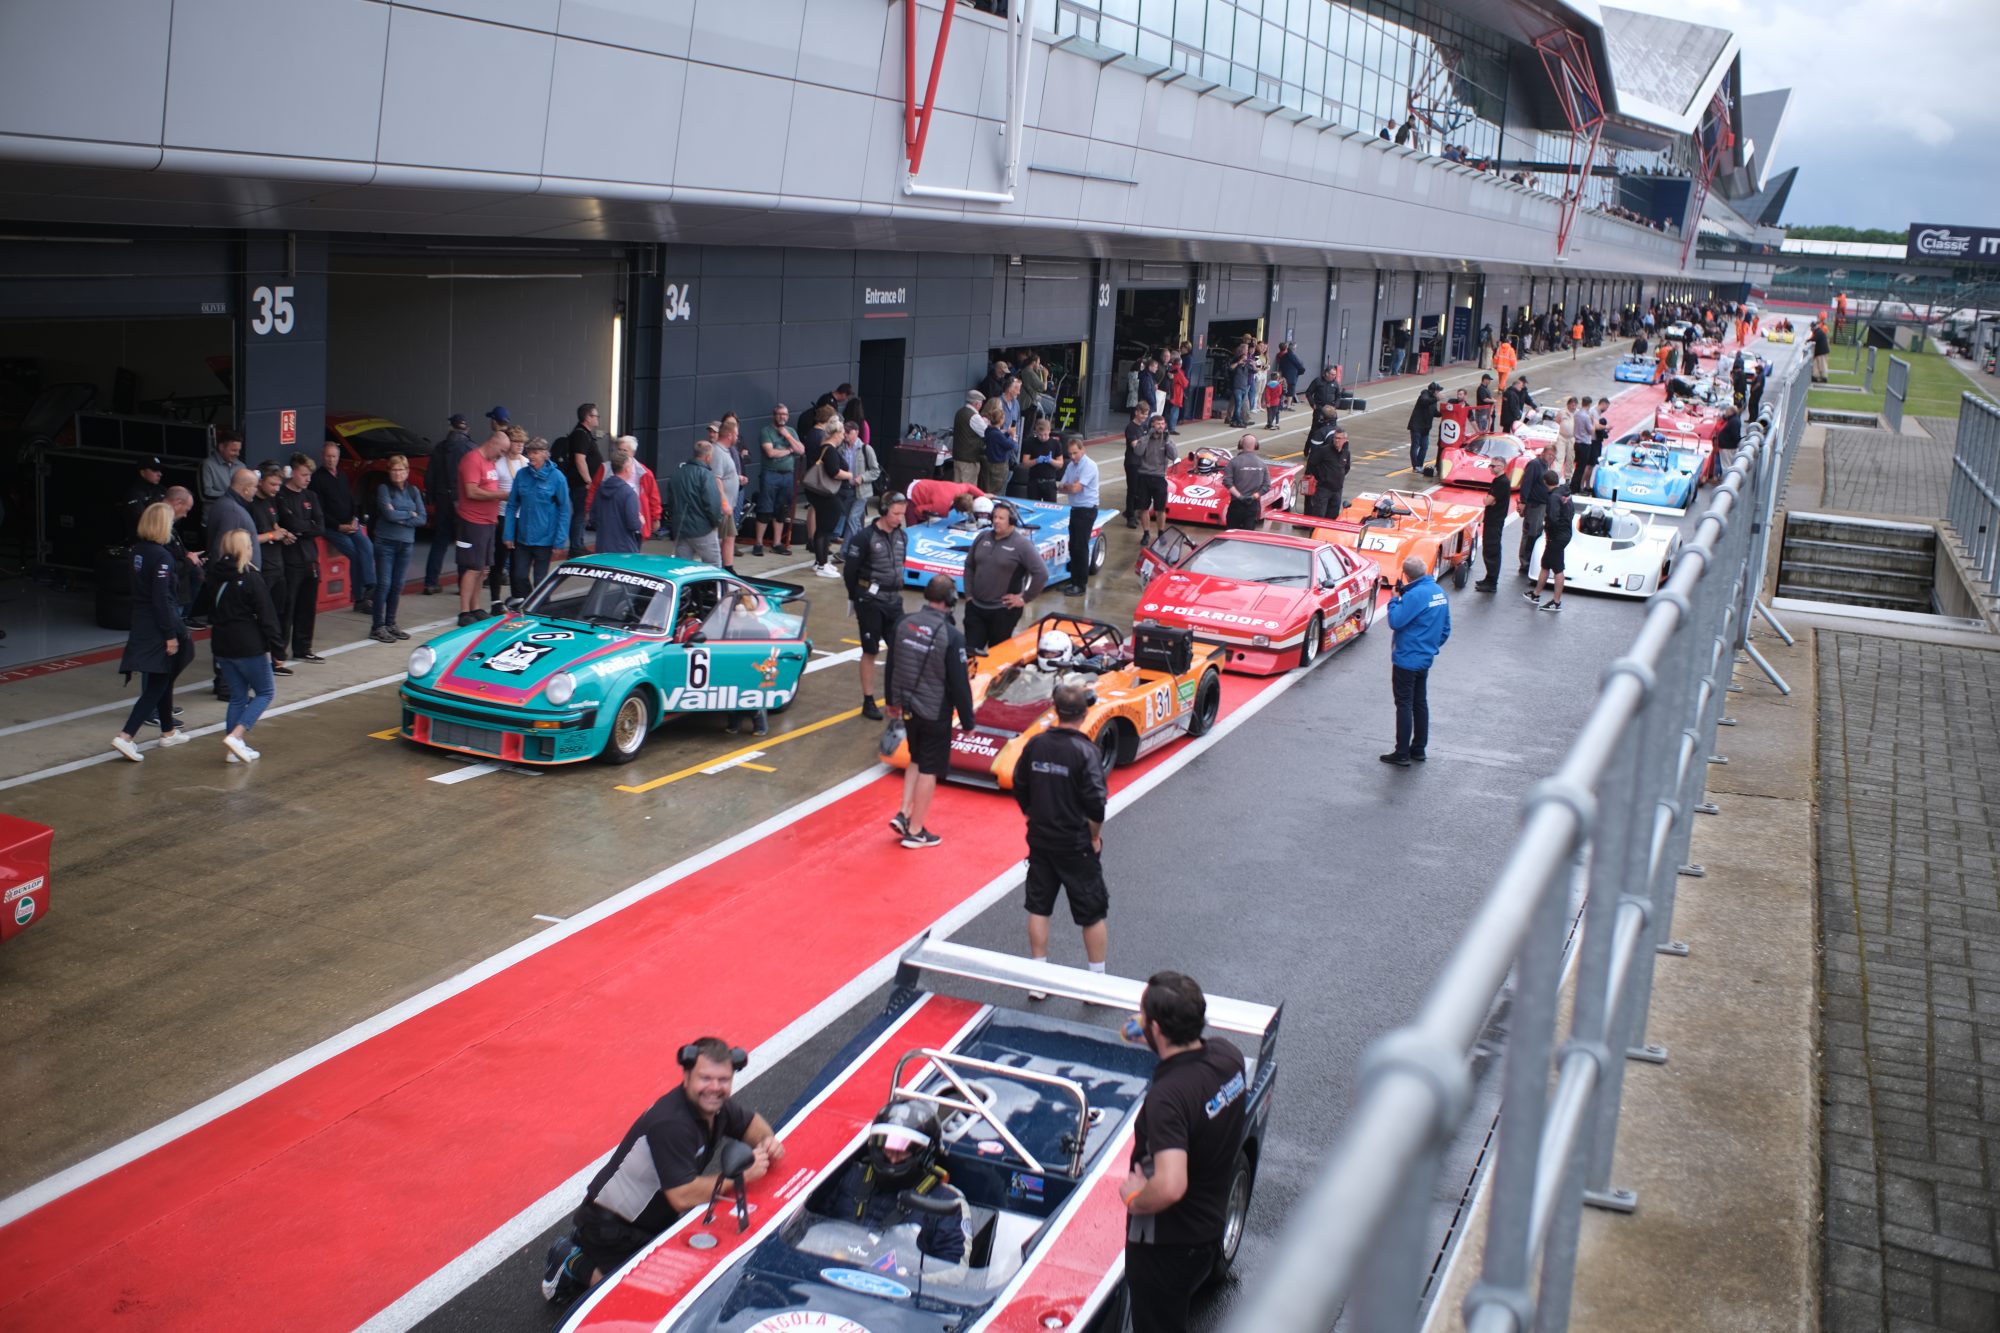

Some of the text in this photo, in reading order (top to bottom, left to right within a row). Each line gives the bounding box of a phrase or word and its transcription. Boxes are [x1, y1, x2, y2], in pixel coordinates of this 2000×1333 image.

[1923, 238, 1969, 251] Classic
[865, 288, 905, 304] Entrance 01
[1100, 283, 1110, 306] 33
[1197, 284, 1206, 304] 32
[1272, 284, 1280, 302] 31
[201, 304, 226, 312] OLIVER
[252, 286, 294, 335] 35
[666, 284, 690, 320] 34
[1443, 422, 1456, 439] 27
[1167, 492, 1220, 508] VALVOLINE
[1189, 487, 1210, 497] 51
[1056, 540, 1066, 557] 29
[1370, 537, 1385, 551] 15
[915, 547, 966, 562] GITAN
[1584, 562, 1603, 573] 14
[558, 567, 666, 592] VAILLANT-KREMER
[1161, 605, 1265, 626] POLAROOF
[690, 649, 708, 689] 6
[661, 682, 797, 711] Vaillan
[1156, 687, 1171, 719] 31
[13, 880, 42, 895] DUNLOP
